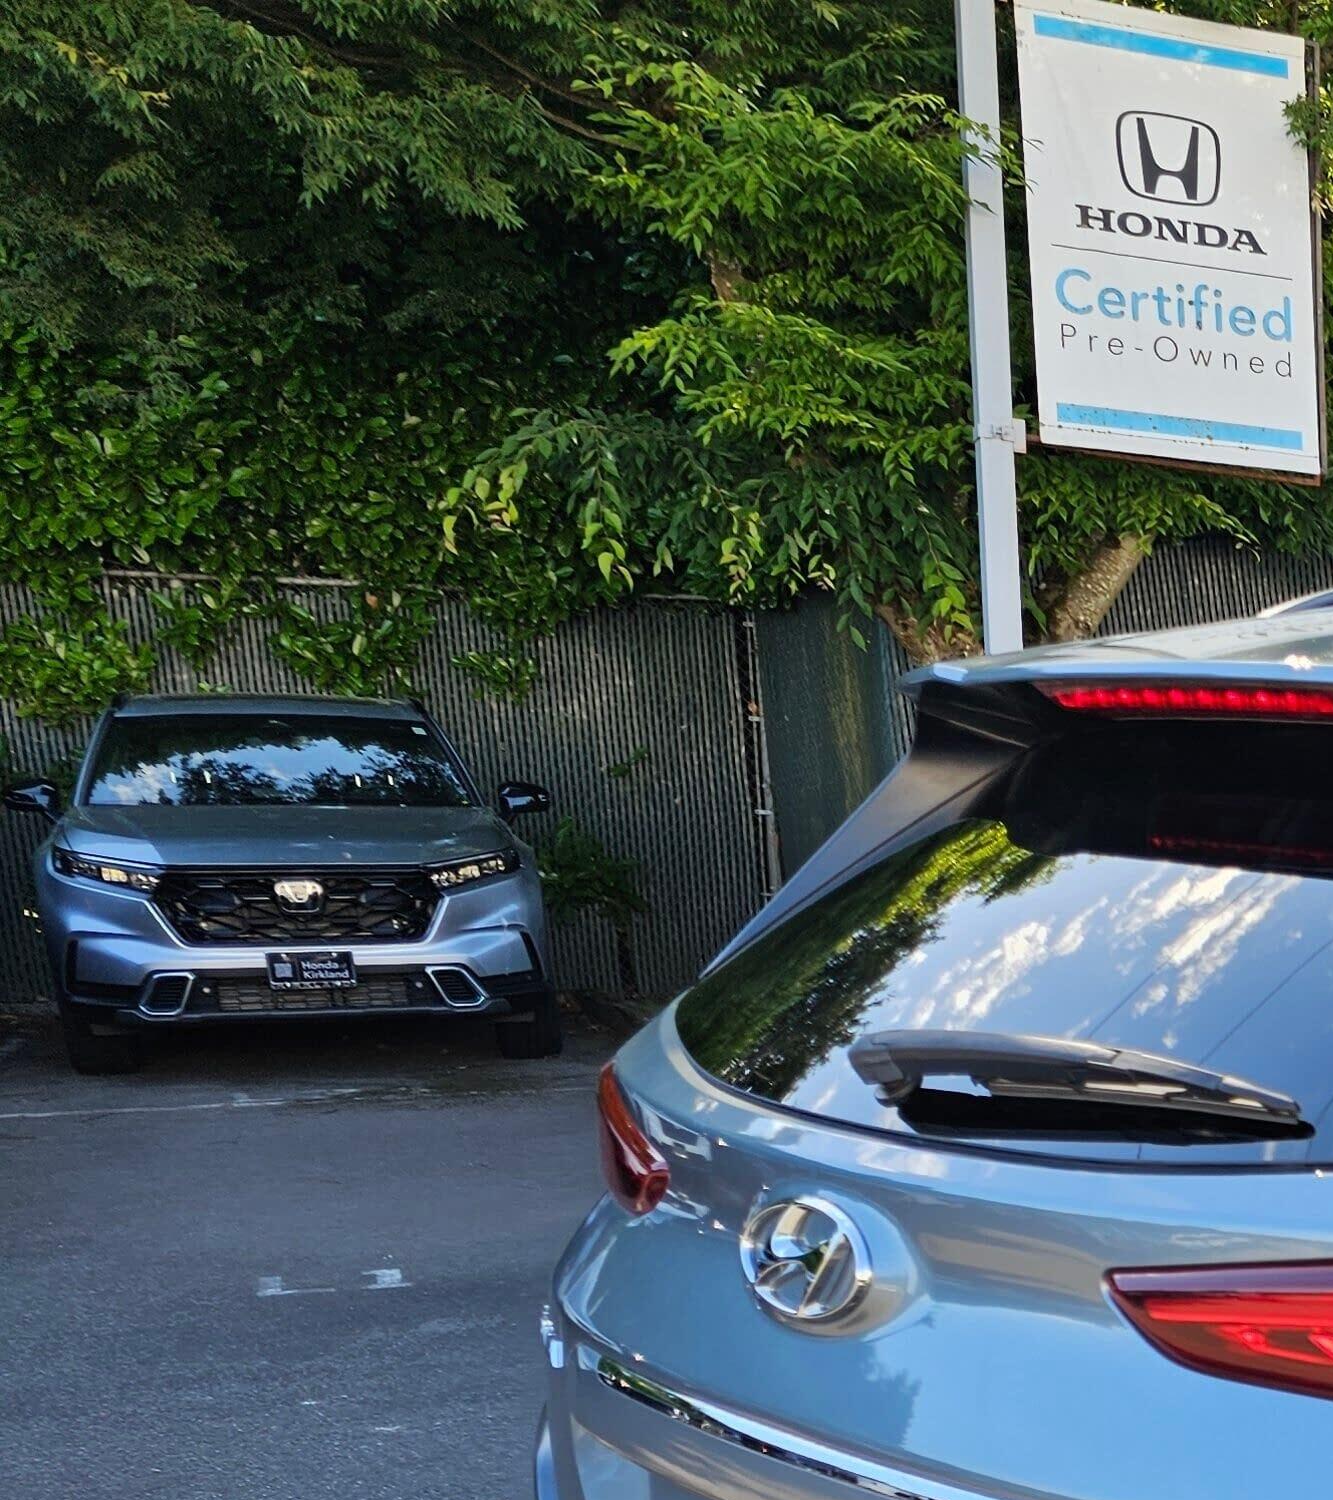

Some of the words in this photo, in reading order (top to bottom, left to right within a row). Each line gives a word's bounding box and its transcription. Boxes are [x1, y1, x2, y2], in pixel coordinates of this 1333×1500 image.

[1075, 203, 1268, 256] HONDA
[1056, 268, 1293, 343] Certified
[1060, 323, 1293, 378] Pre-Owned
[300, 960, 339, 969] Honda
[303, 969, 350, 979] Kirkland
